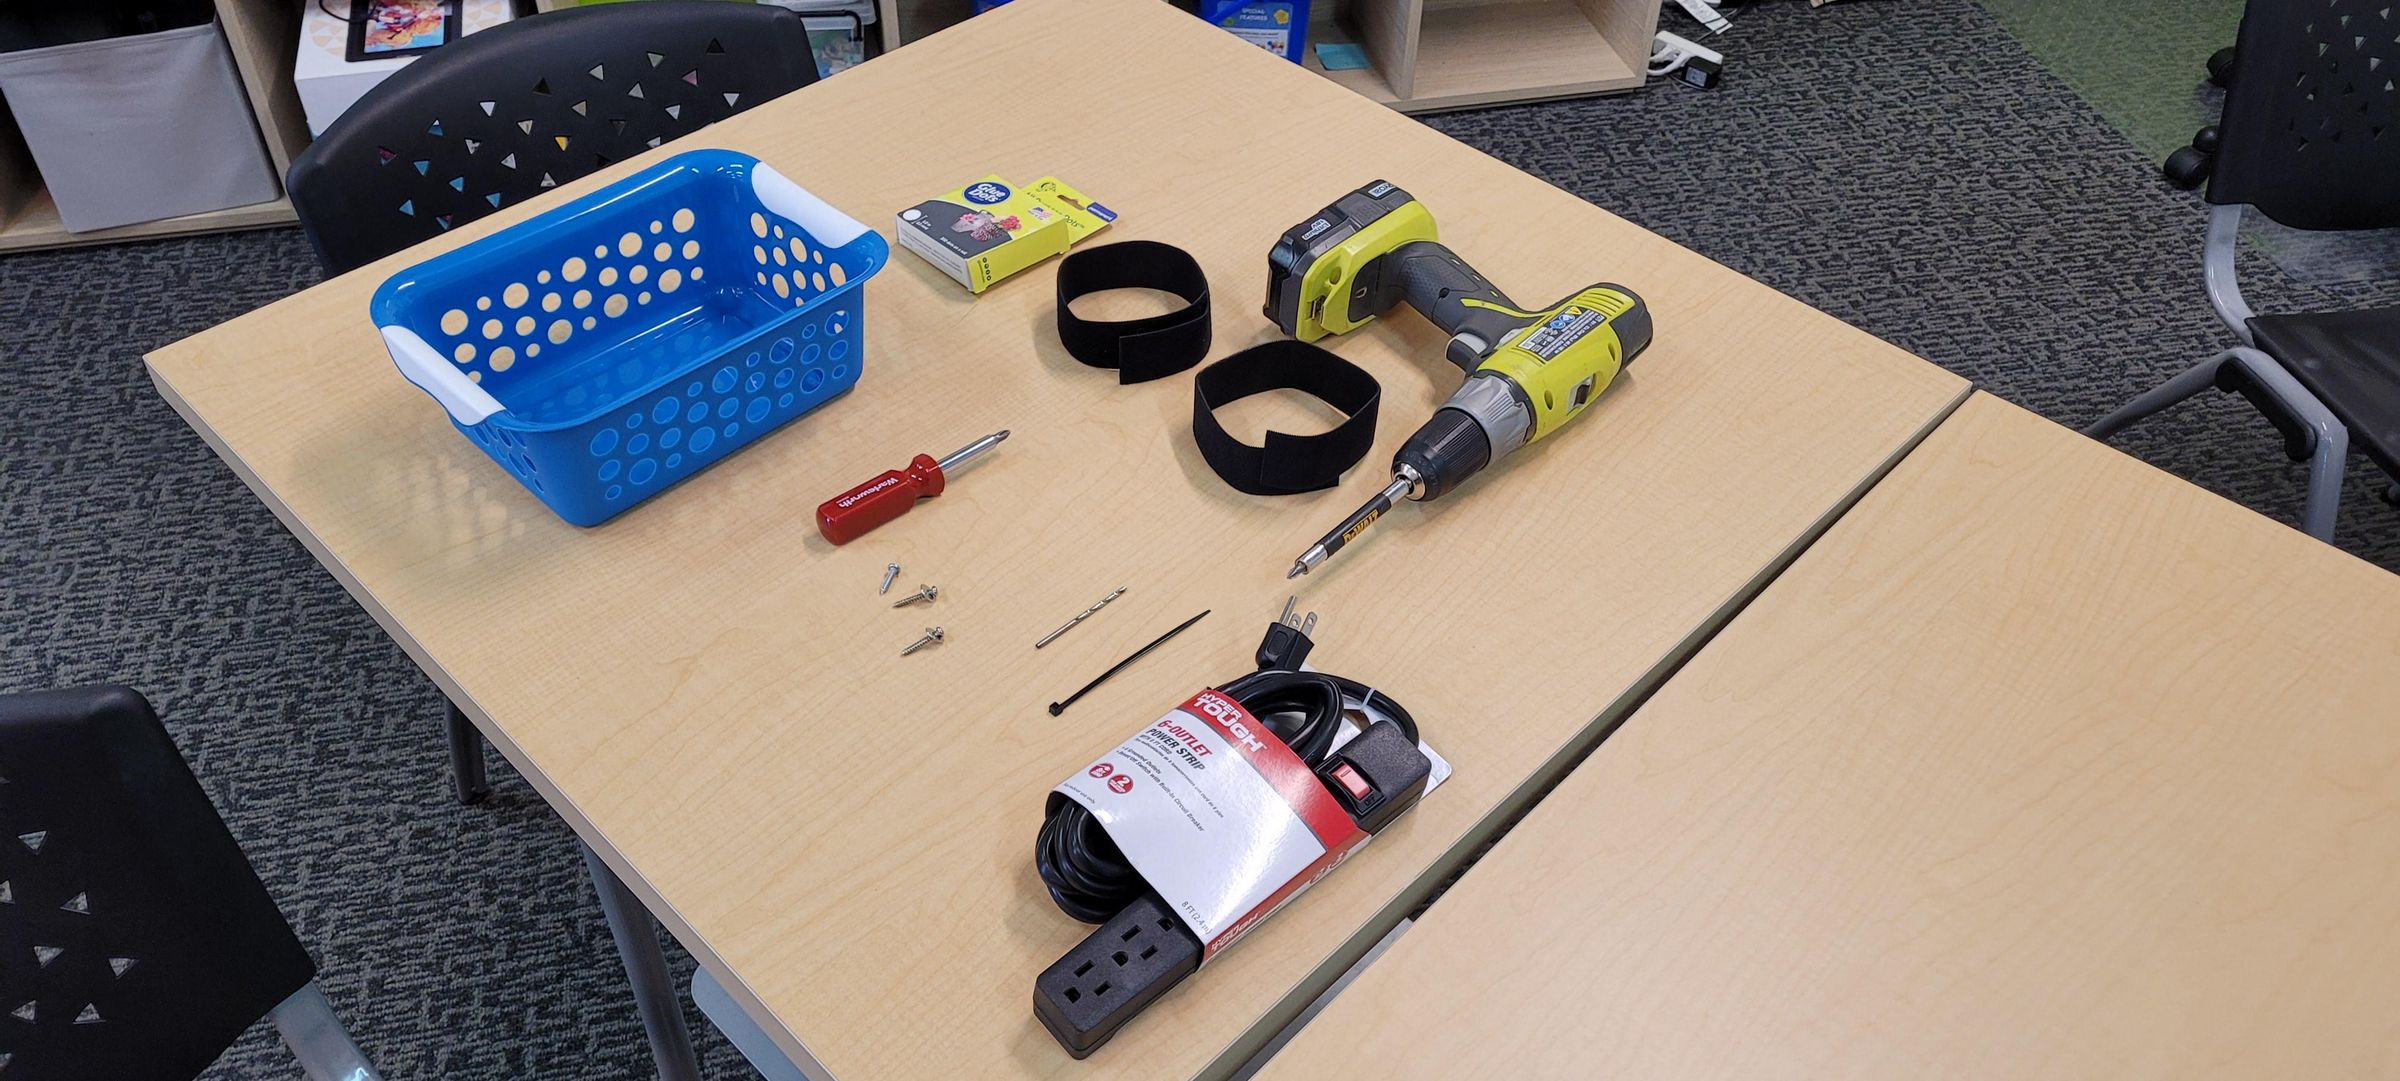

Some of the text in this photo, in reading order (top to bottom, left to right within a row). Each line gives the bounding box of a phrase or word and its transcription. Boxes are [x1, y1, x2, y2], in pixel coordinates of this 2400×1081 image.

[967, 188, 999, 202] Dots
[977, 183, 1006, 197] Glue
[838, 477, 898, 508] Wadsworth
[1200, 693, 1242, 721] HYPER
[1157, 719, 1213, 757] 6-OUTLET
[1193, 697, 1265, 753] TOUGH
[1145, 728, 1180, 749] POWER
[1176, 747, 1205, 770] STRIP
[1116, 775, 1131, 787] 2
[1173, 797, 1189, 814] Circuit
[1186, 812, 1205, 831] Breaker
[1185, 904, 1196, 914] FT
[1190, 911, 1205, 926] (2.4
